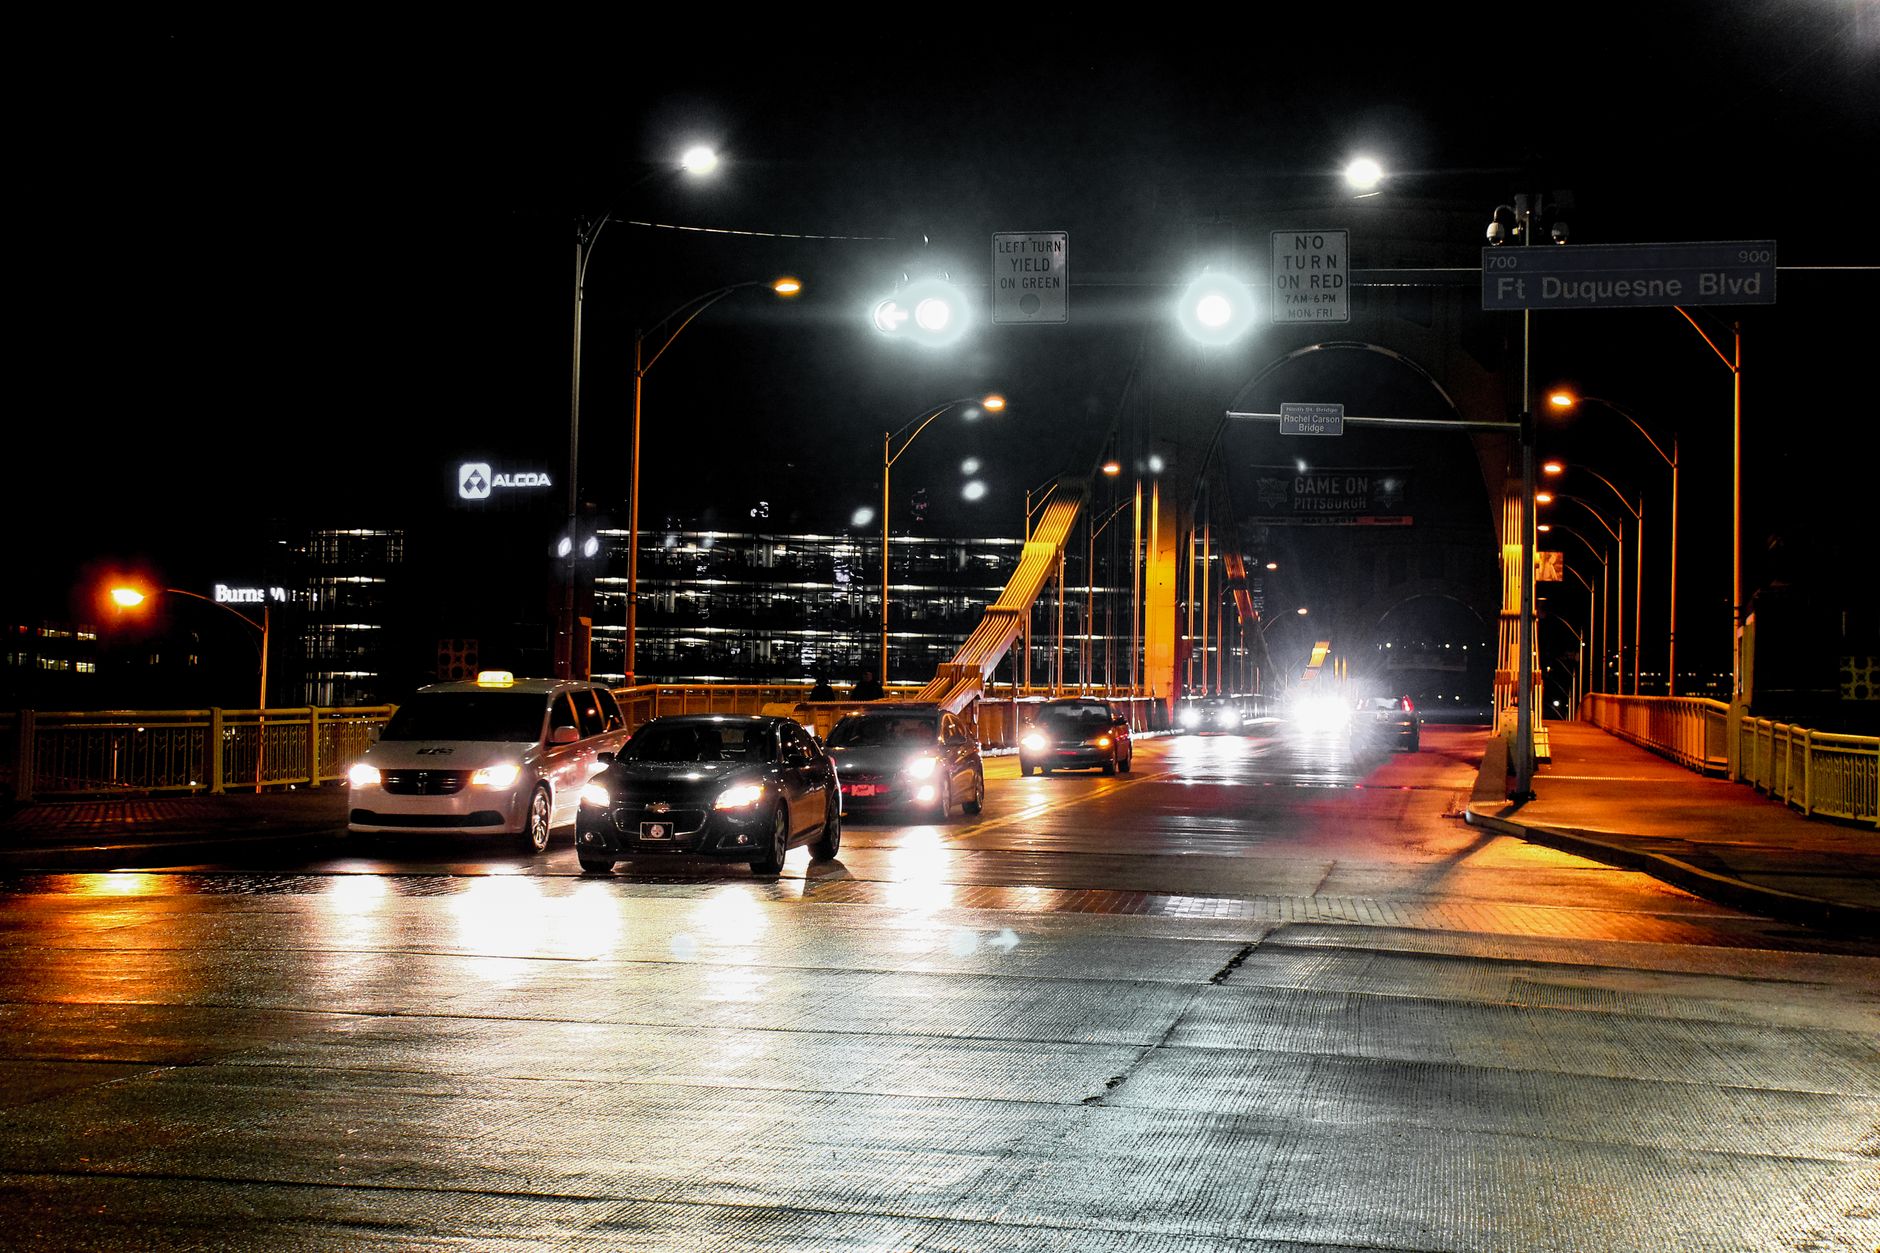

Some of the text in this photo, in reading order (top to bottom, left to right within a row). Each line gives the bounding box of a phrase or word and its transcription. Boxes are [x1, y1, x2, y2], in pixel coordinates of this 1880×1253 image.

[1000, 241, 1061, 253] LEFT TURN
[1295, 235, 1324, 250] NO
[1284, 254, 1337, 269] TURN
[1488, 256, 1517, 268] 700
[1738, 250, 1770, 262] 900
[1011, 258, 1050, 272] YIELD
[1000, 277, 1060, 289] ON GREEN
[1277, 274, 1343, 289] ON RED
[1498, 272, 1761, 303] Ft Duquesne Blvd
[1284, 414, 1340, 423] Rachel Carson
[1298, 423, 1325, 433] Bridge
[492, 472, 552, 487] ALCOA
[1294, 477, 1369, 494] GAME ON
[1294, 497, 1367, 510] PITTSBURGH
[215, 584, 265, 602] Burns
